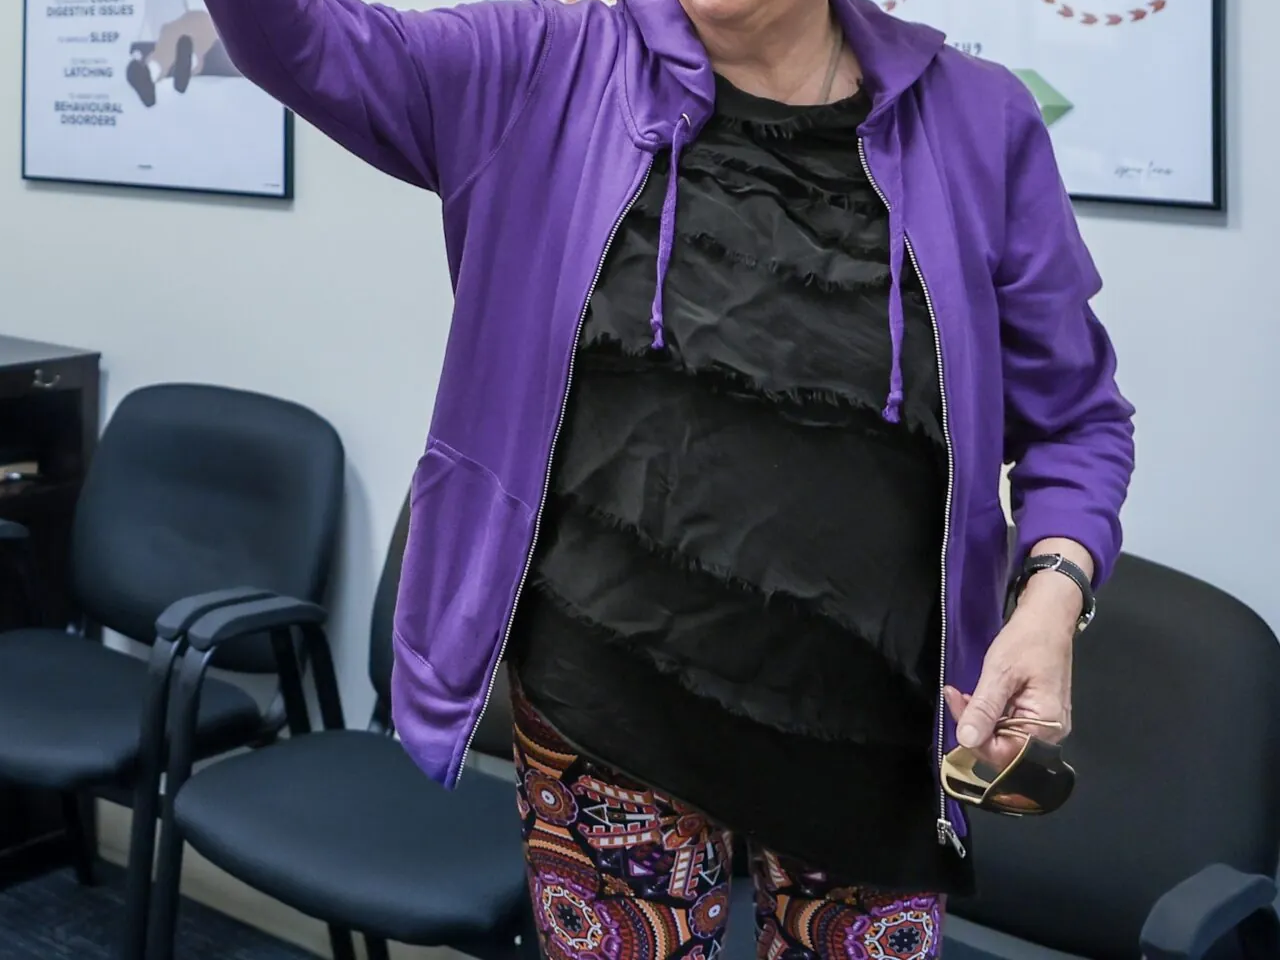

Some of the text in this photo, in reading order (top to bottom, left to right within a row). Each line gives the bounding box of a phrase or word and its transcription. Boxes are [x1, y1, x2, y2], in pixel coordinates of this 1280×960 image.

[46, 4, 134, 17] DIGESTIVE ISSUES
[89, 31, 120, 43] SLEEP
[63, 67, 113, 78] LATCHING
[54, 101, 124, 114] BEHAVIOURAL
[60, 114, 117, 127] DISORDERS
